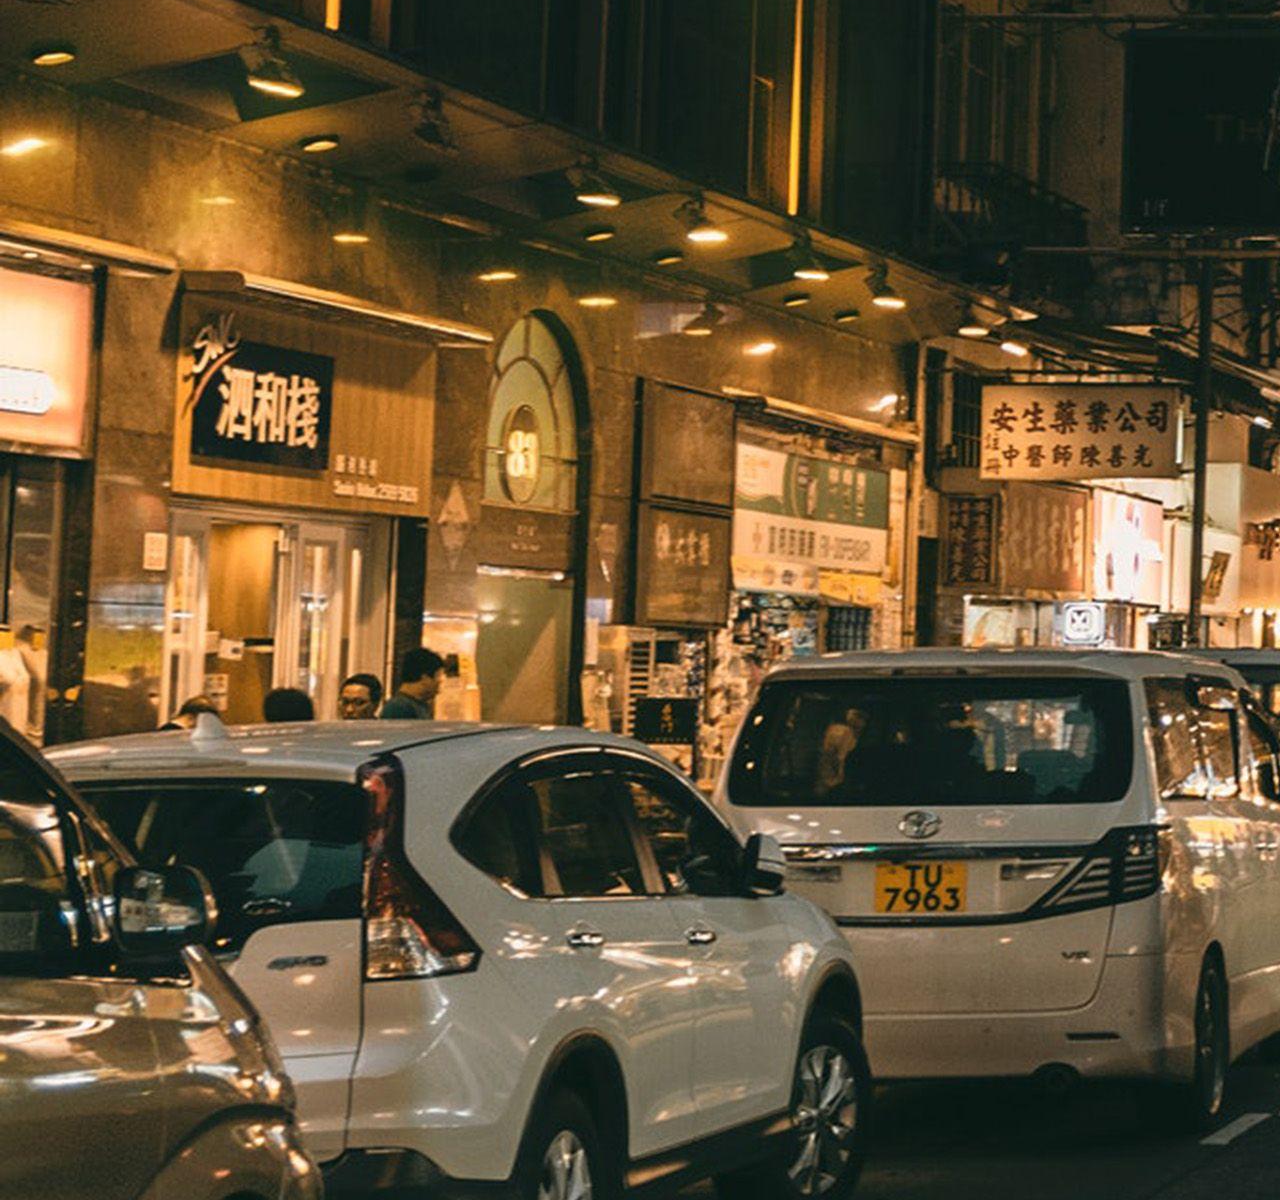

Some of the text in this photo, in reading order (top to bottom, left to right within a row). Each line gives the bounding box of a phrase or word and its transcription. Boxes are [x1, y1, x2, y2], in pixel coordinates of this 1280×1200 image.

[989, 400, 1170, 434] 安生藥業公司
[905, 865, 943, 890] TU
[884, 887, 961, 912] 7963
